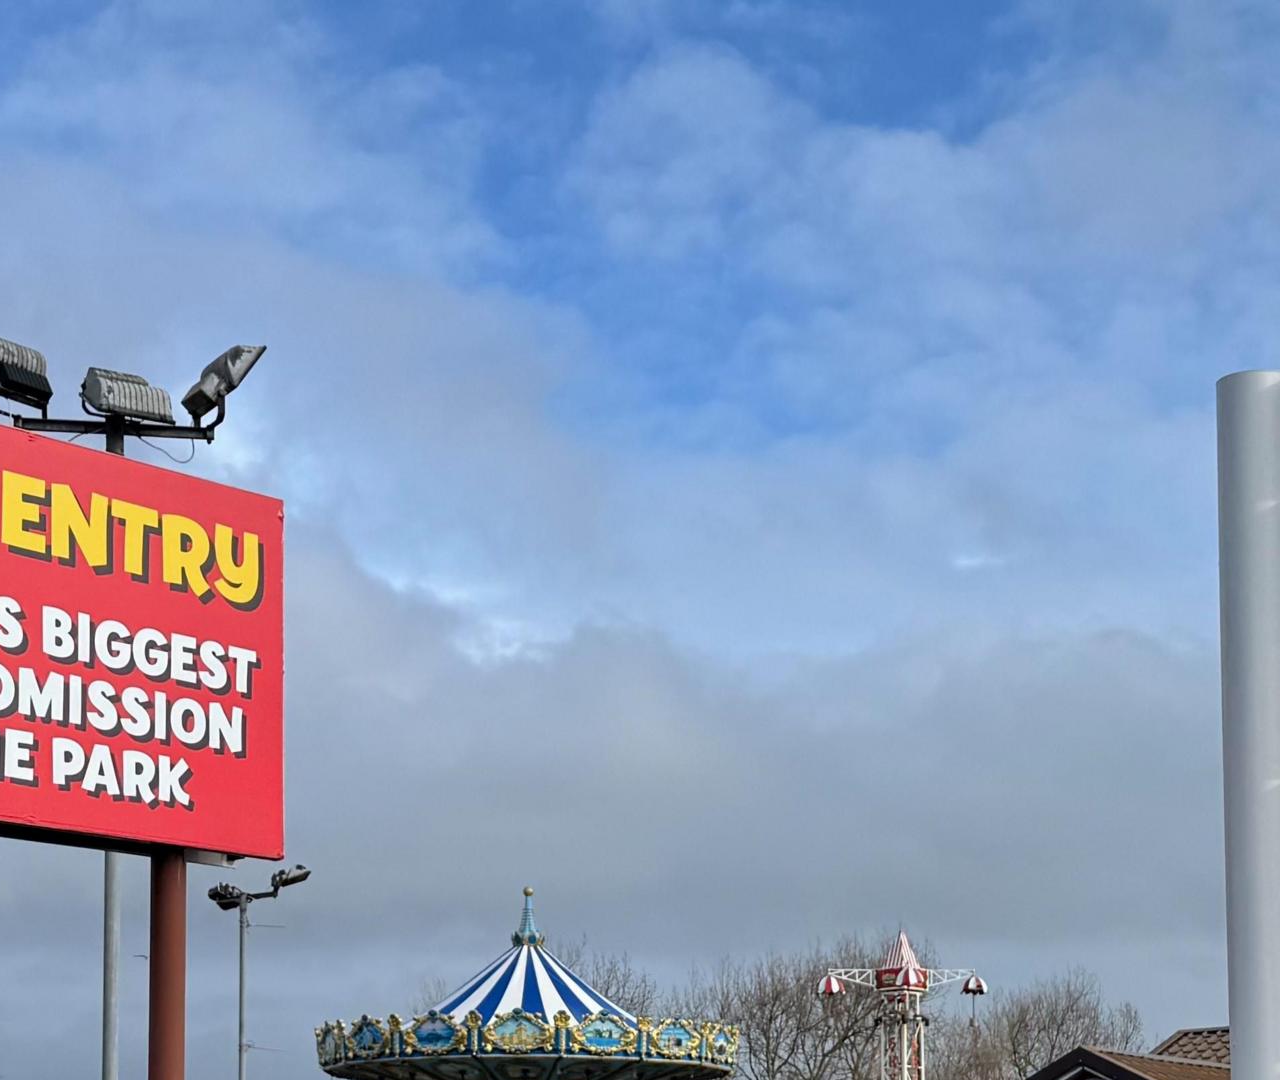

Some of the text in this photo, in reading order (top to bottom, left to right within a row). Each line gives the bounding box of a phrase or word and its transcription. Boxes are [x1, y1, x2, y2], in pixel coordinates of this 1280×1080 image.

[1, 470, 261, 605] ENTRY
[41, 607, 258, 696] BIGGEST
[52, 739, 193, 808] PARK
